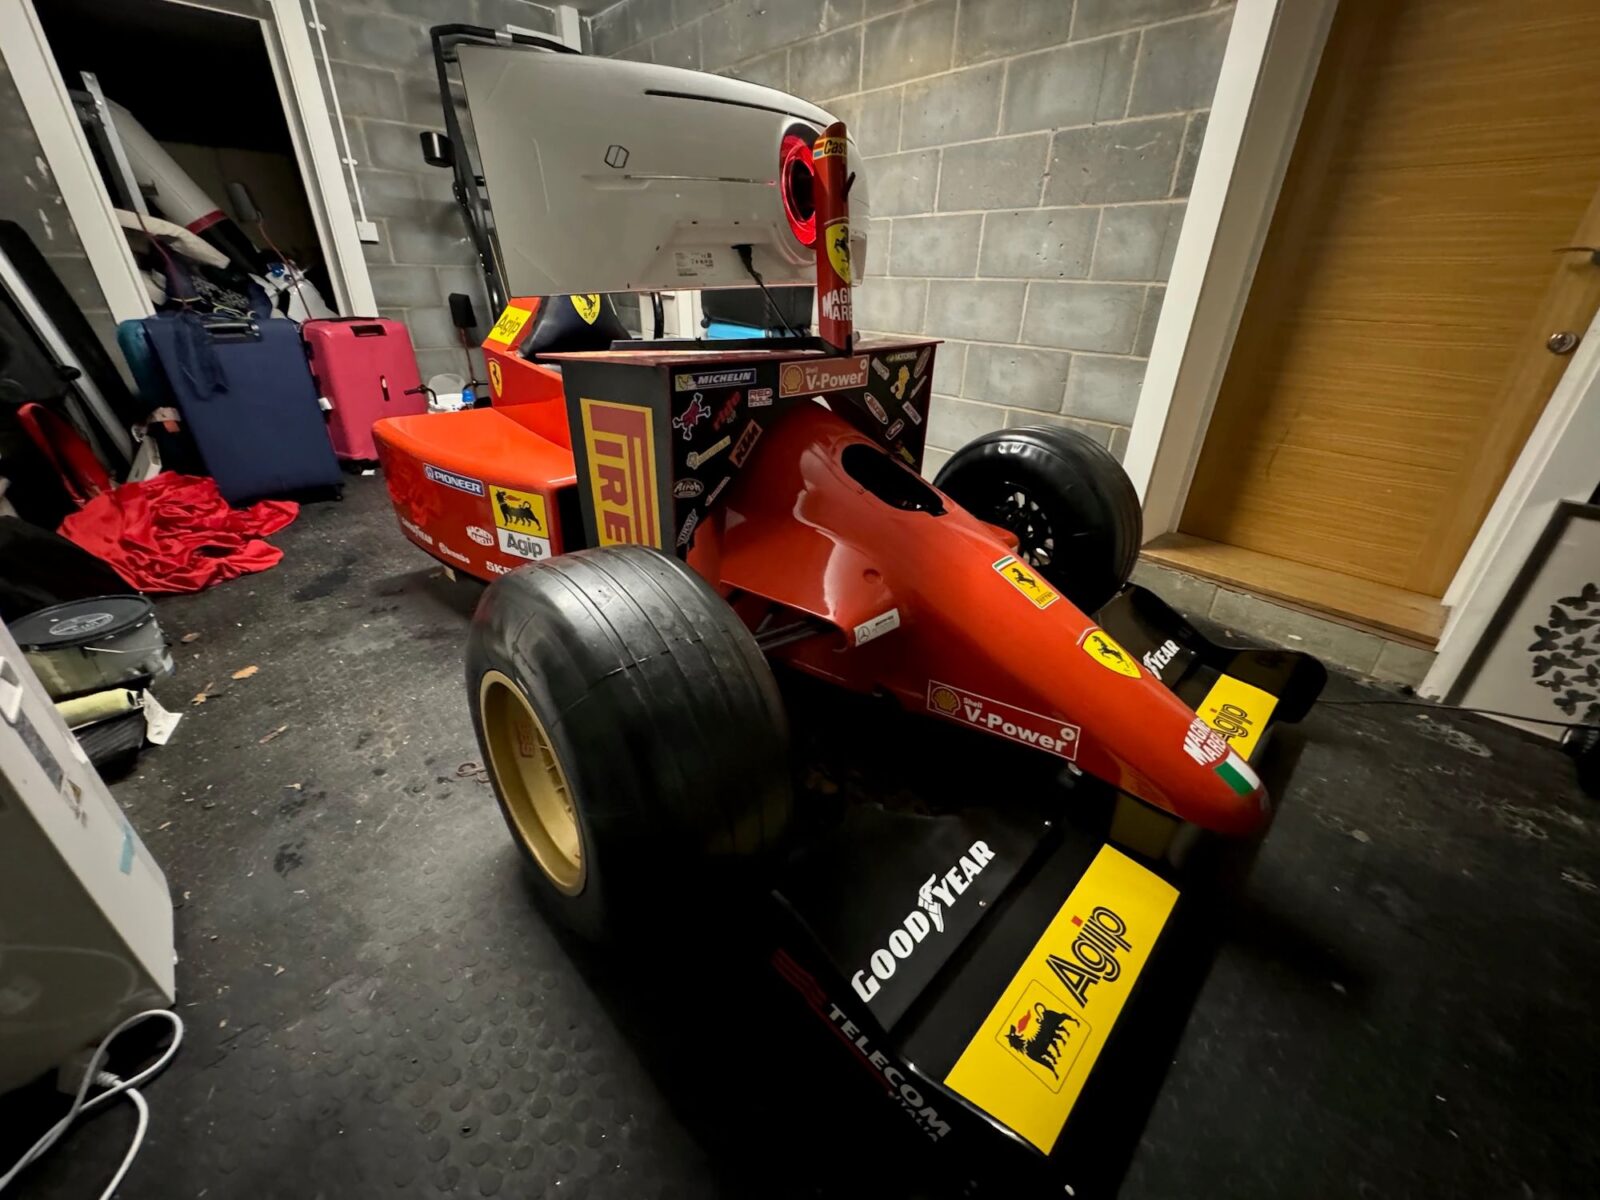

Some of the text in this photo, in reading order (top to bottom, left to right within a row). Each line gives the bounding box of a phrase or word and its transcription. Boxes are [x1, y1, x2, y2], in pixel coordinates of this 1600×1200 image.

[497, 313, 520, 337] Agip
[697, 371, 752, 385] MICHELIN
[806, 373, 863, 390] V-Power
[434, 471, 482, 494] PIONEER
[589, 404, 655, 547] PIRE
[507, 533, 543, 557] Agip
[963, 697, 983, 709] Shell
[964, 704, 1069, 753] V-Power
[851, 839, 995, 1004] GOODYEAR
[1046, 906, 1133, 1007] Agip
[827, 1003, 951, 1139] TELECOM
[892, 1093, 939, 1143] ITALIA
